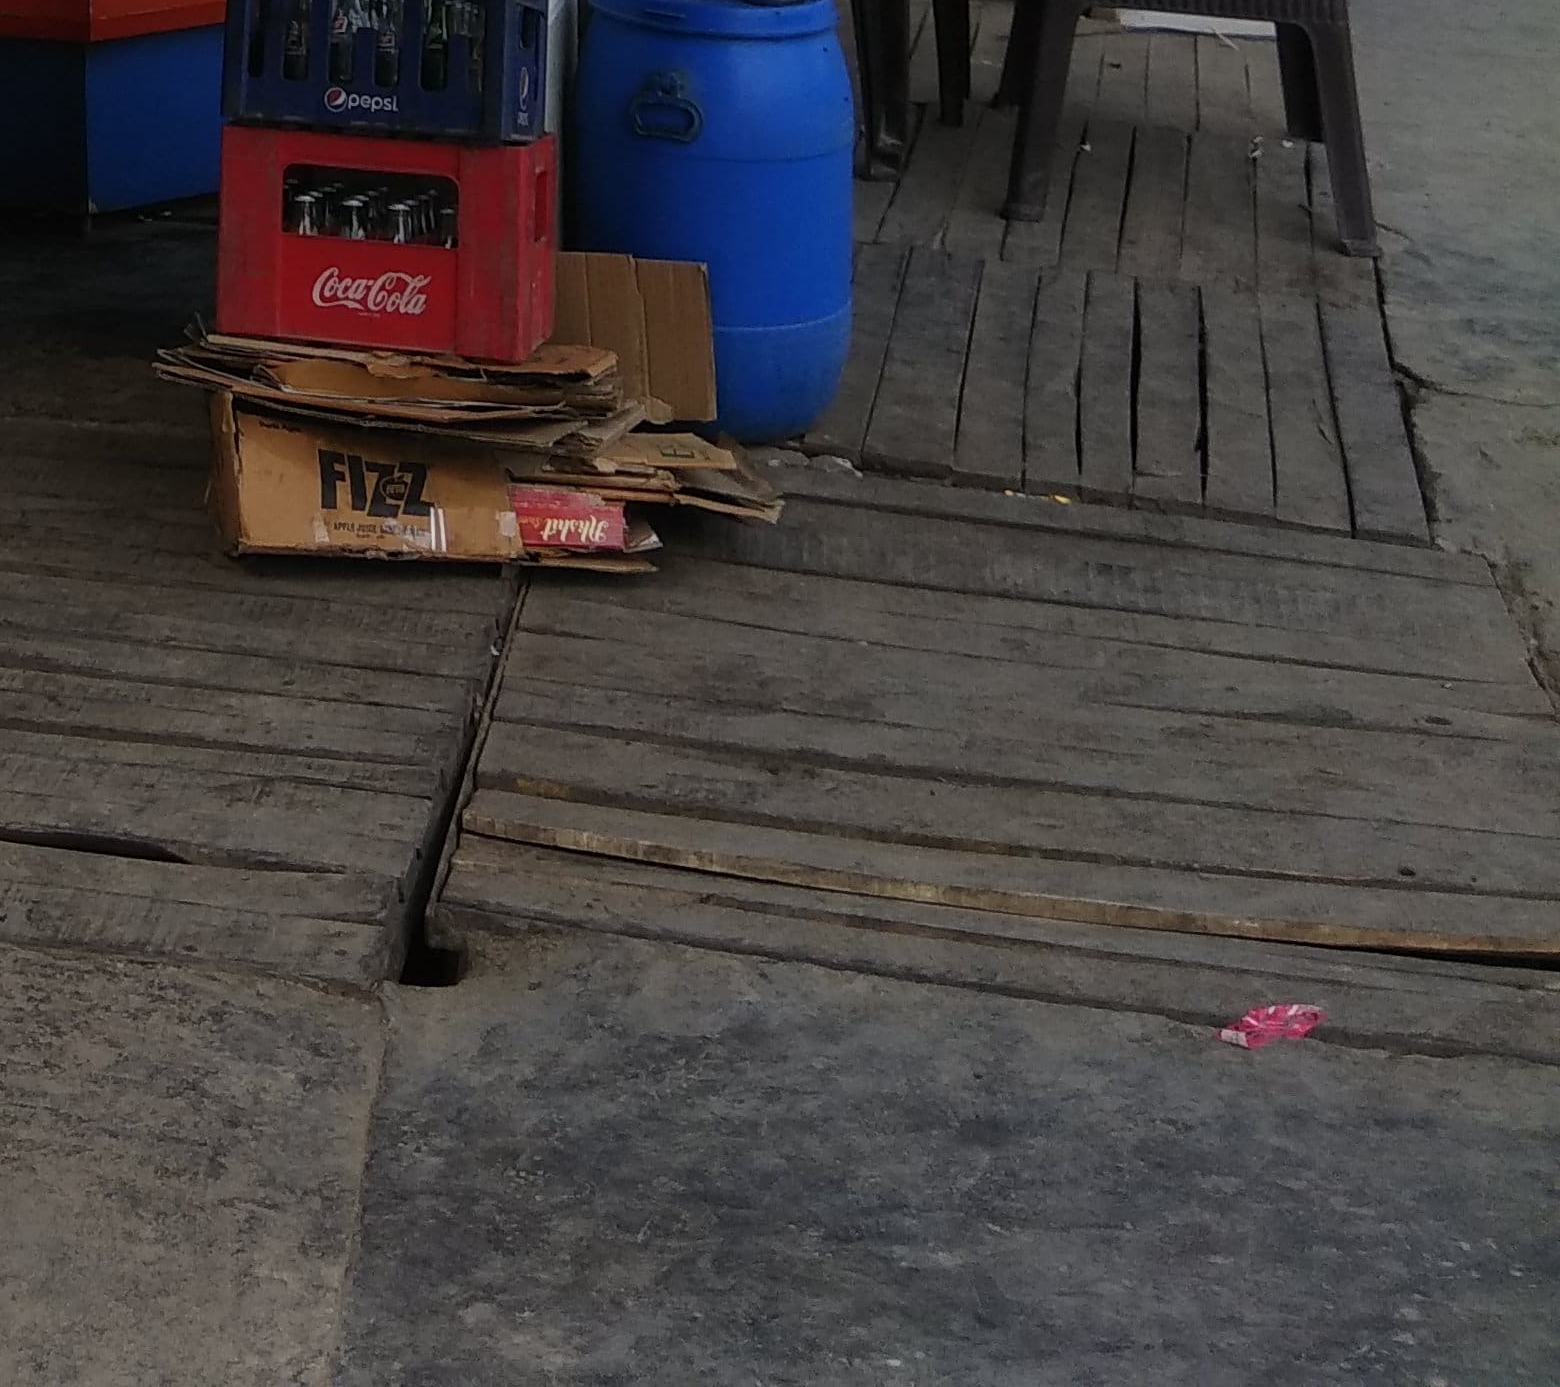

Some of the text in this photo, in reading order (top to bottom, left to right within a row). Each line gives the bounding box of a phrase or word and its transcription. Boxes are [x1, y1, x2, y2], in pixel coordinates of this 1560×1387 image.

[347, 93, 400, 114] pepsi
[312, 266, 433, 316] Coca-Cola
[317, 448, 435, 518] FIZZ
